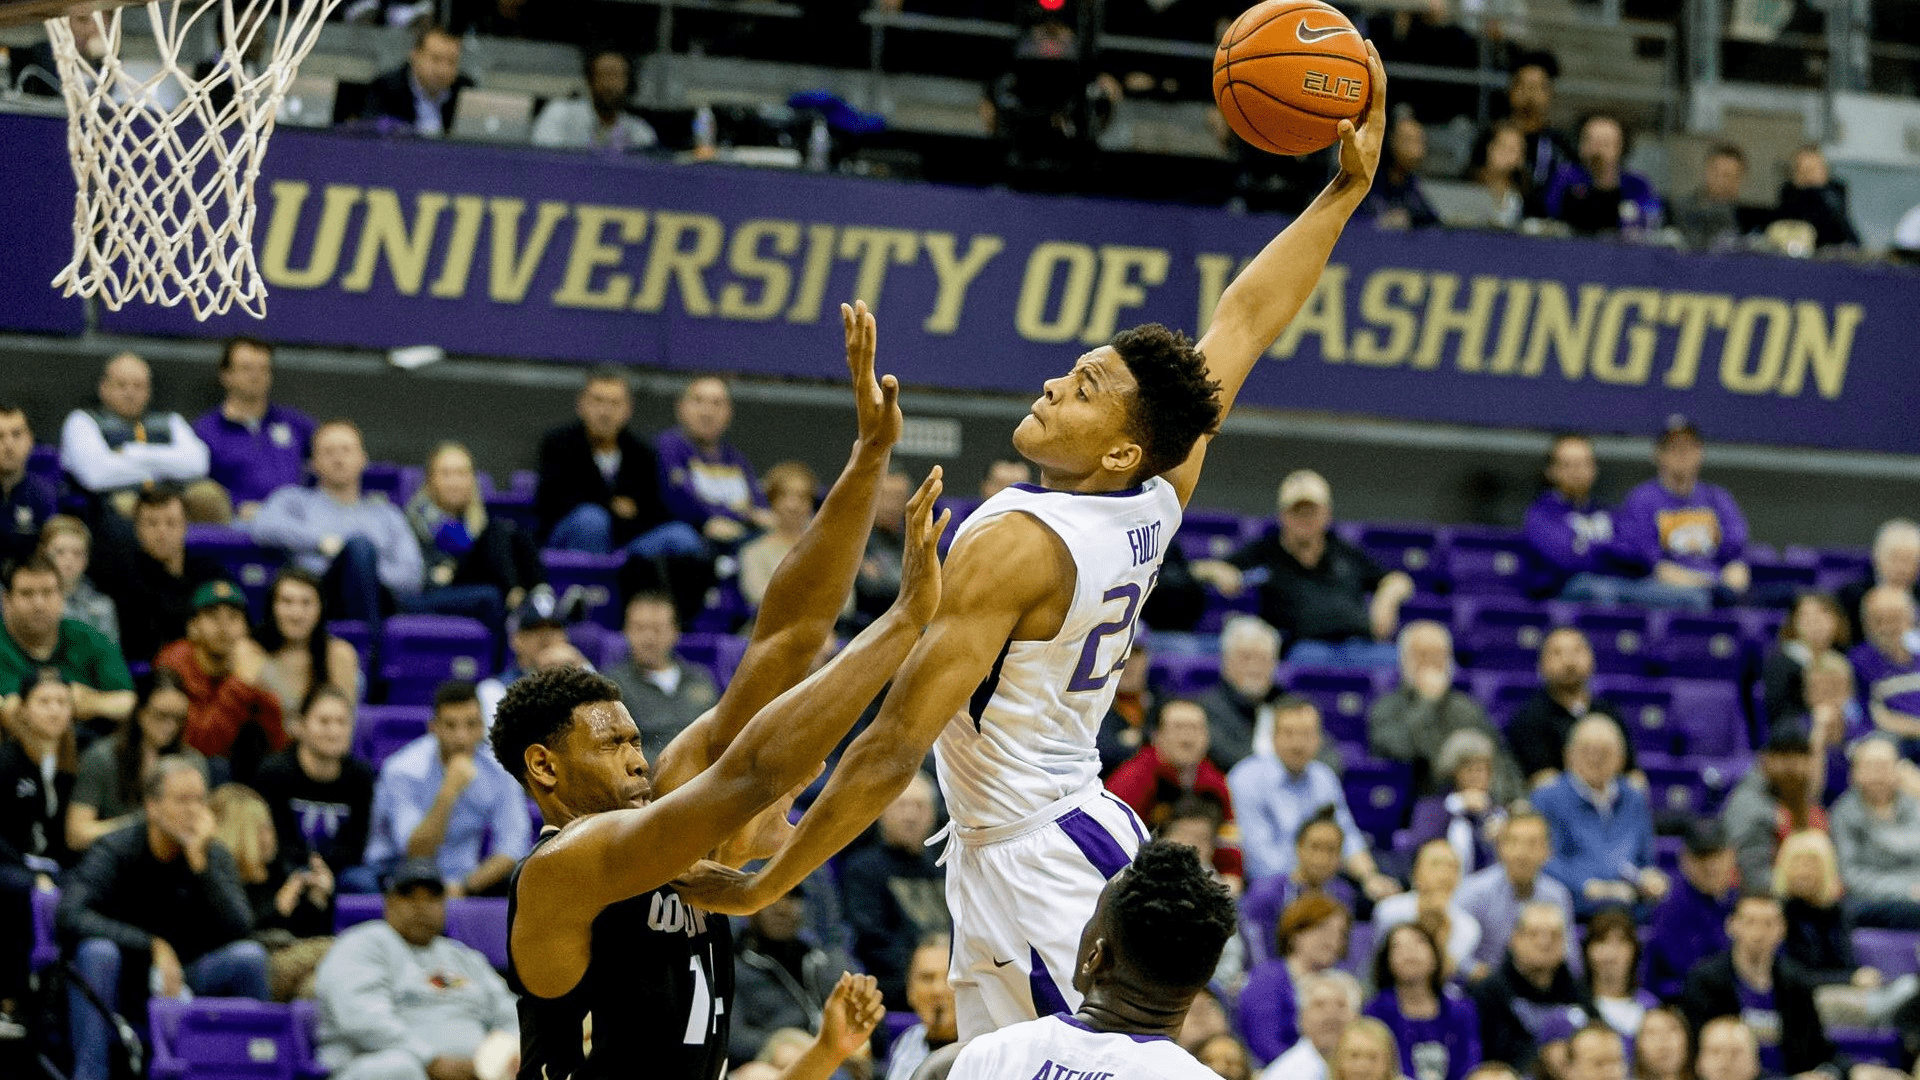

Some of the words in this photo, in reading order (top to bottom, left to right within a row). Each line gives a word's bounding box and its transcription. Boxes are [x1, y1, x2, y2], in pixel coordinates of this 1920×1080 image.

[1302, 70, 1362, 100] ELITE
[261, 178, 1004, 335] UNIVERSITY
[1015, 240, 1171, 345] OF
